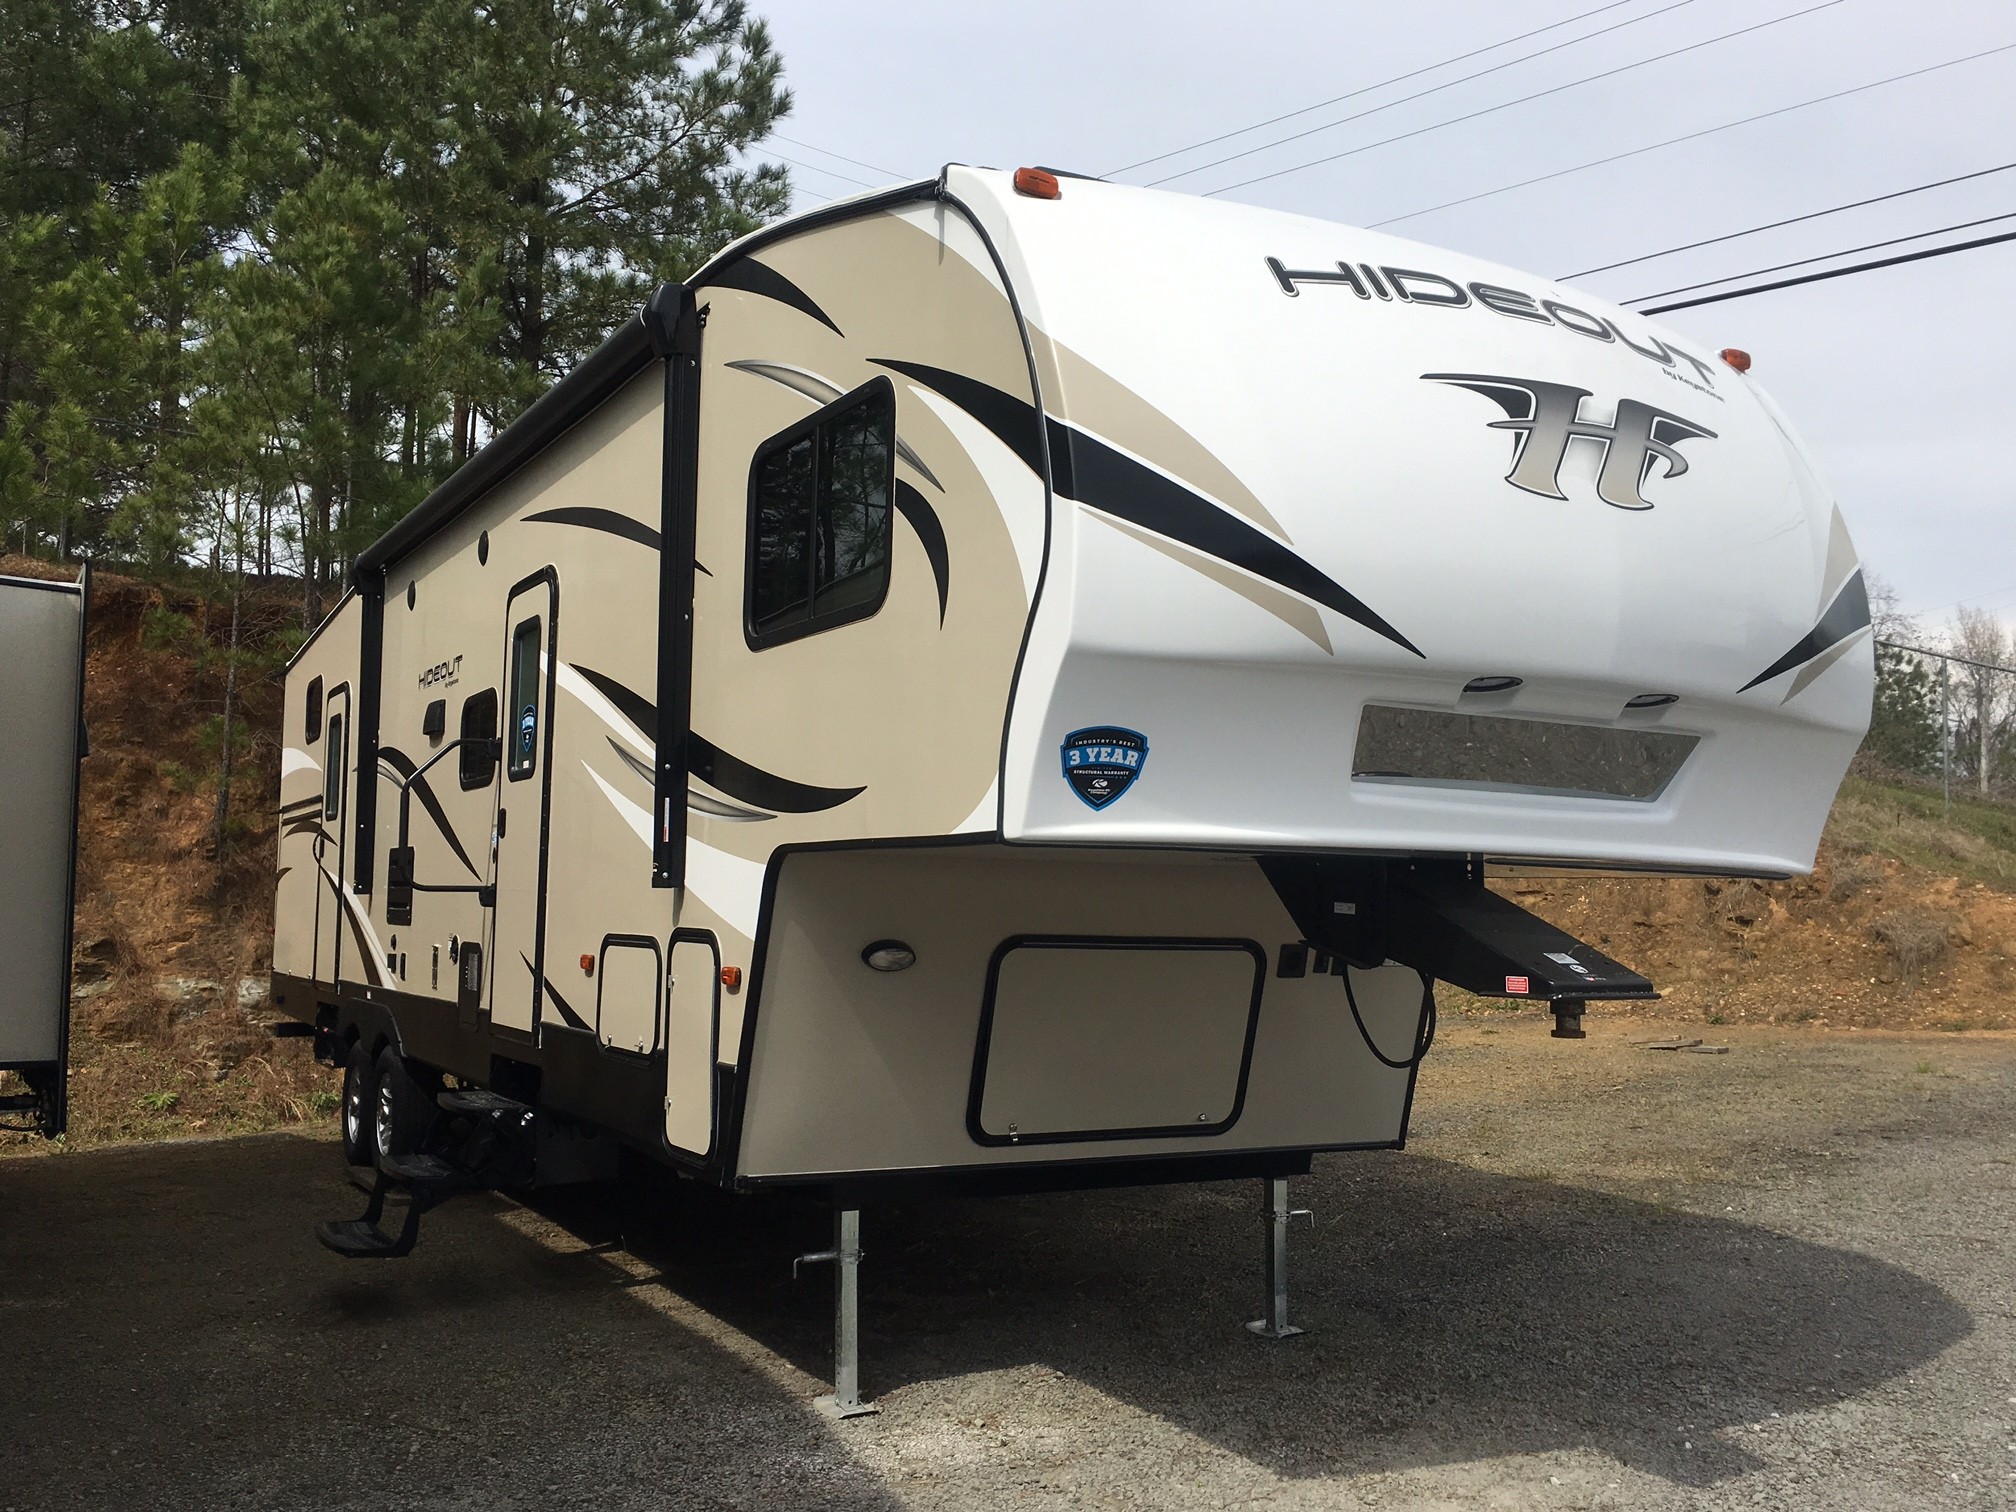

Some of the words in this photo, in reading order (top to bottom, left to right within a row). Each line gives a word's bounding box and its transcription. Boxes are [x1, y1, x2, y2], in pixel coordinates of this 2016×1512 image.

[1264, 256, 1716, 389] HIDEOUT
[1661, 366, 1677, 380] by
[417, 653, 463, 690] HIDEOUT
[1069, 750, 1081, 766] 3
[1086, 748, 1139, 766] YEAR
